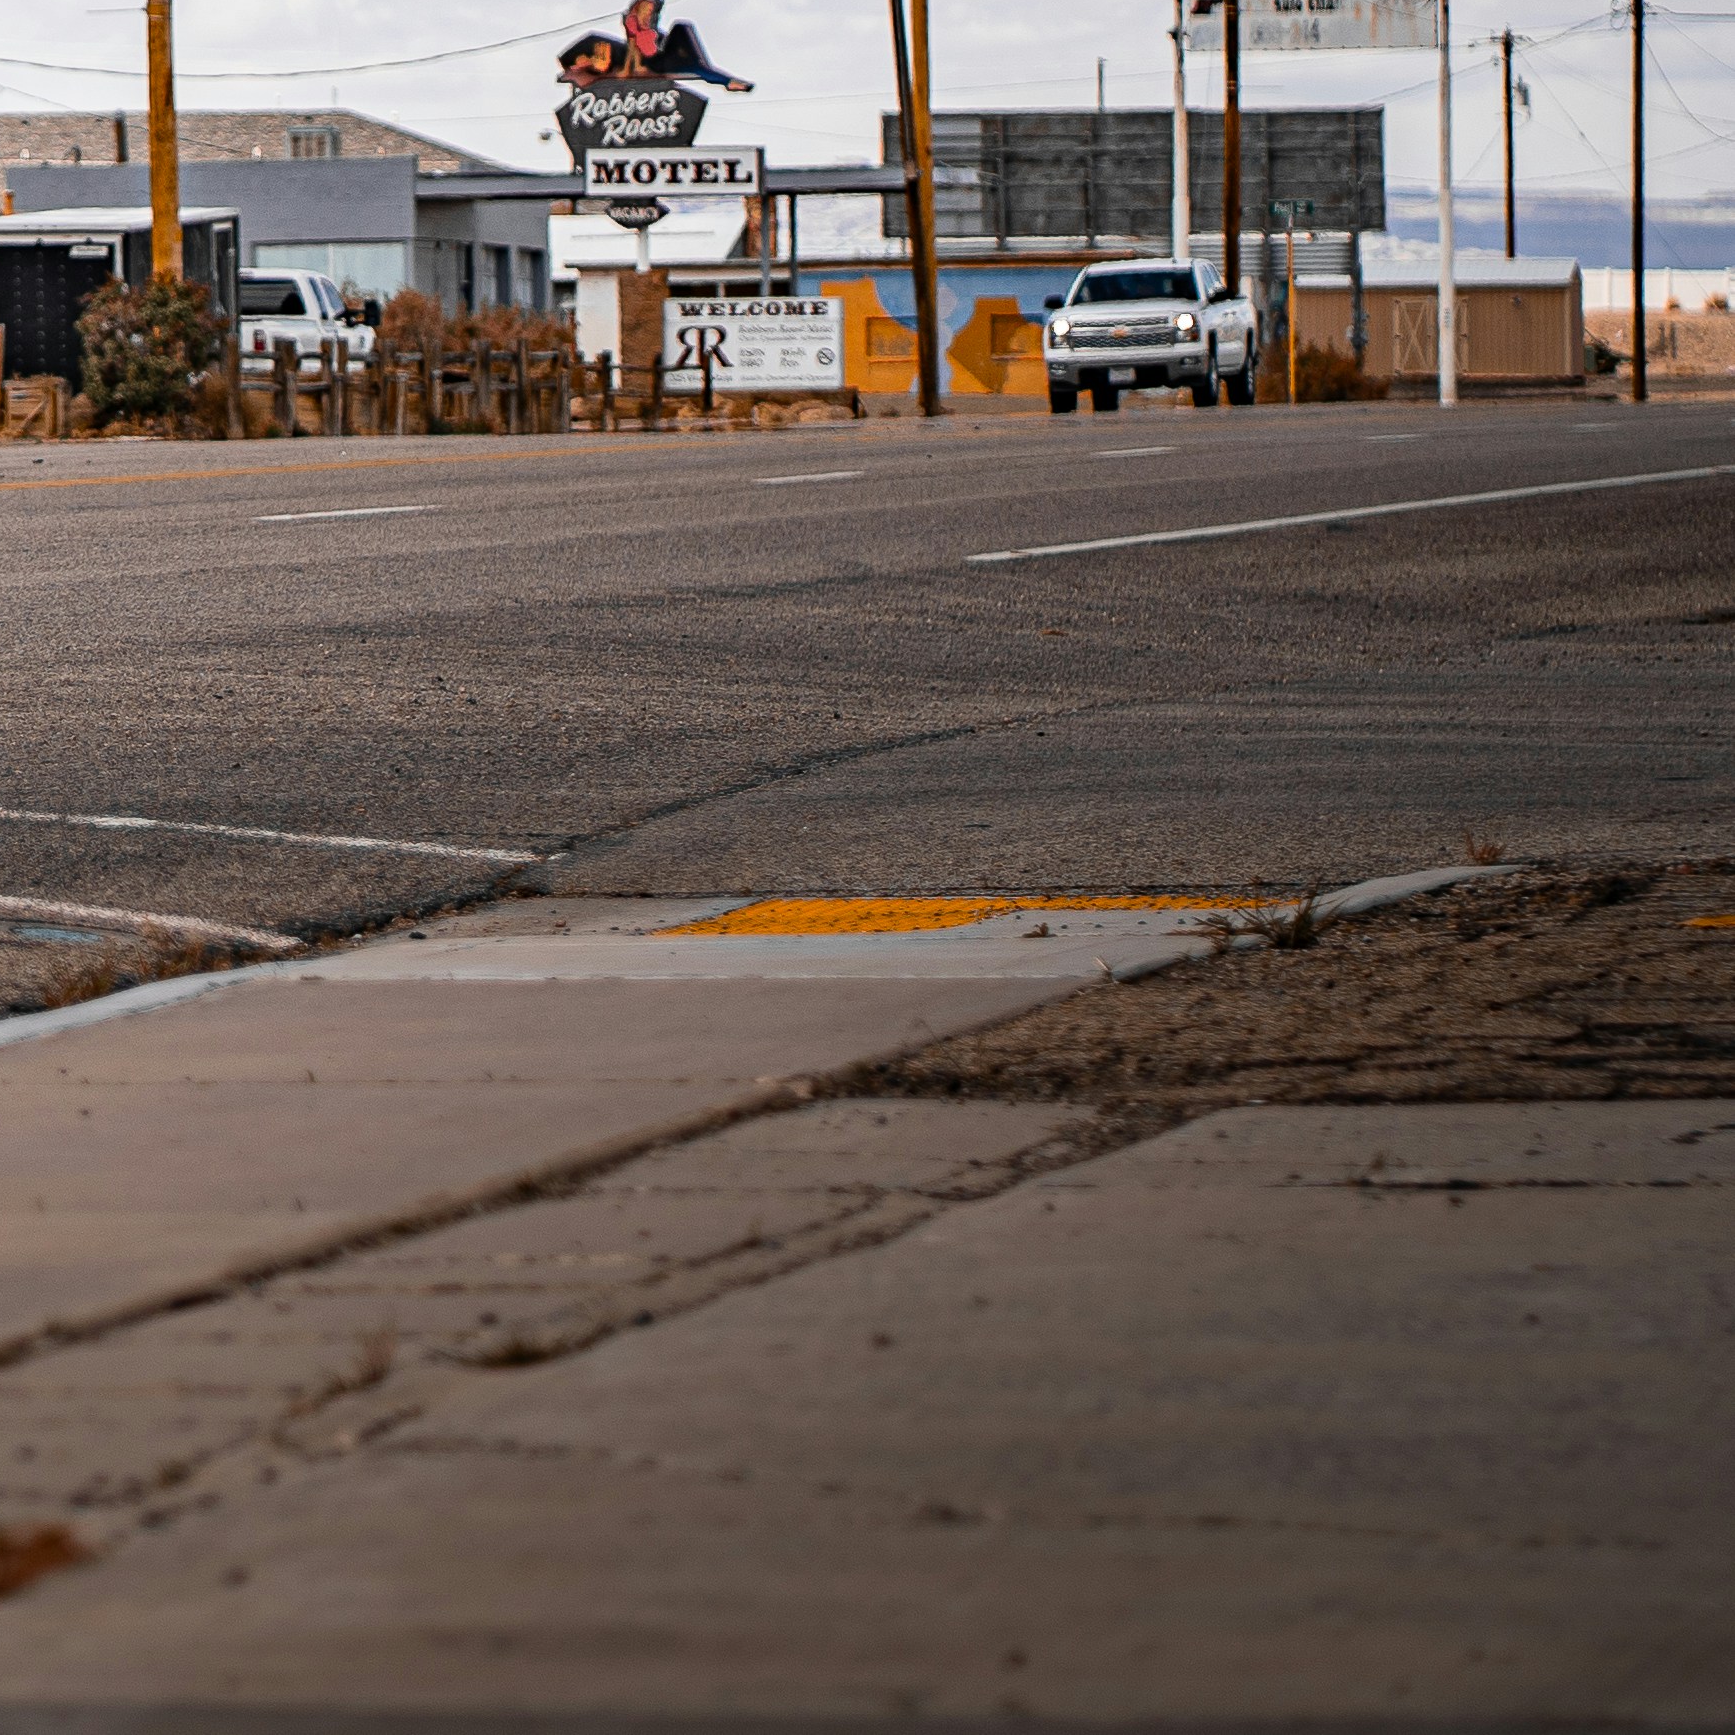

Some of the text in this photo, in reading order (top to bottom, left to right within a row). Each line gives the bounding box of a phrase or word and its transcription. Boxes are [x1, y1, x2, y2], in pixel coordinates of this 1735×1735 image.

[570, 89, 681, 129] Robbers
[601, 110, 684, 147] Roost
[592, 159, 753, 184] MOTEL
[678, 300, 829, 316] WELCOME
